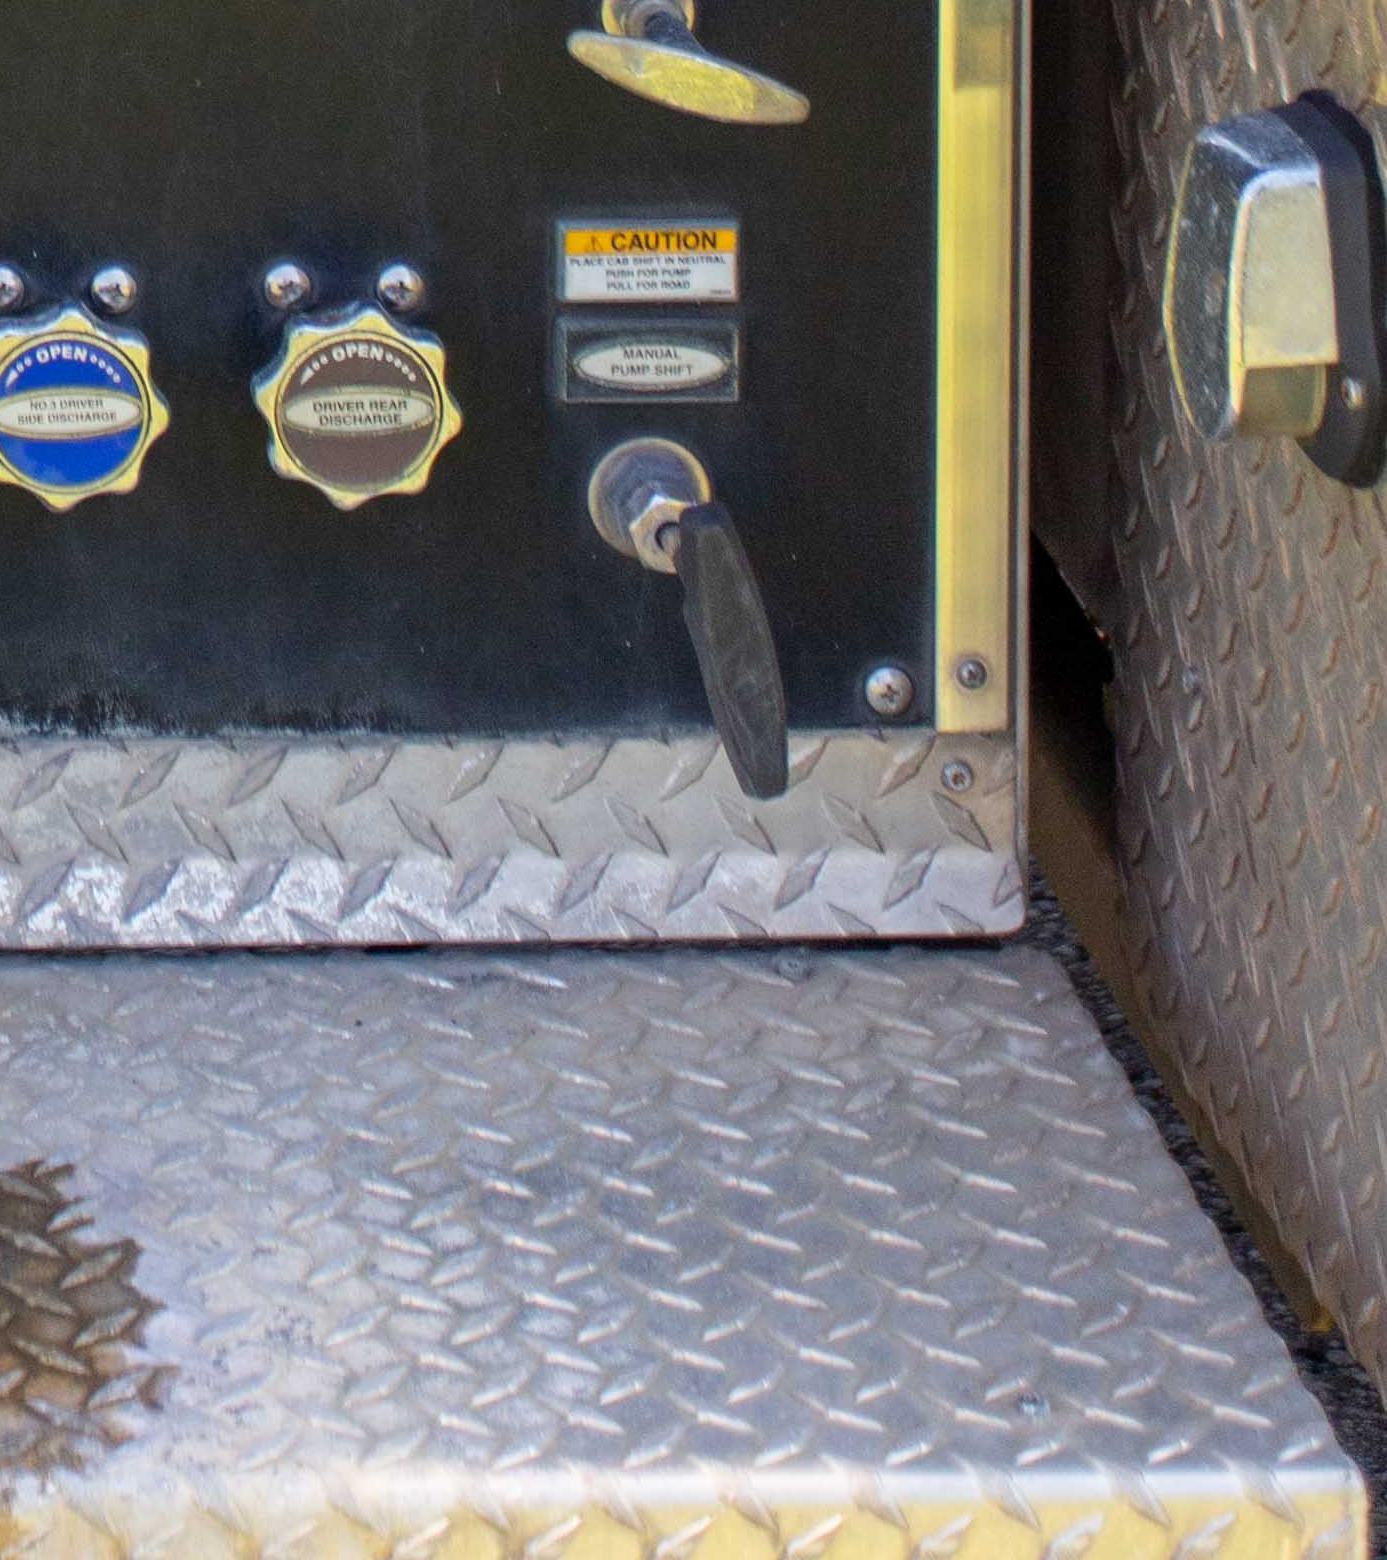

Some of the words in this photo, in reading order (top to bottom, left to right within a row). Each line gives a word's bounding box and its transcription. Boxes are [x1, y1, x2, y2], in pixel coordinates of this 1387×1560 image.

[611, 230, 718, 252] CAUTION
[36, 345, 87, 364] OPEN
[611, 365, 650, 377] PUMP
[655, 364, 693, 376] SHIFT
